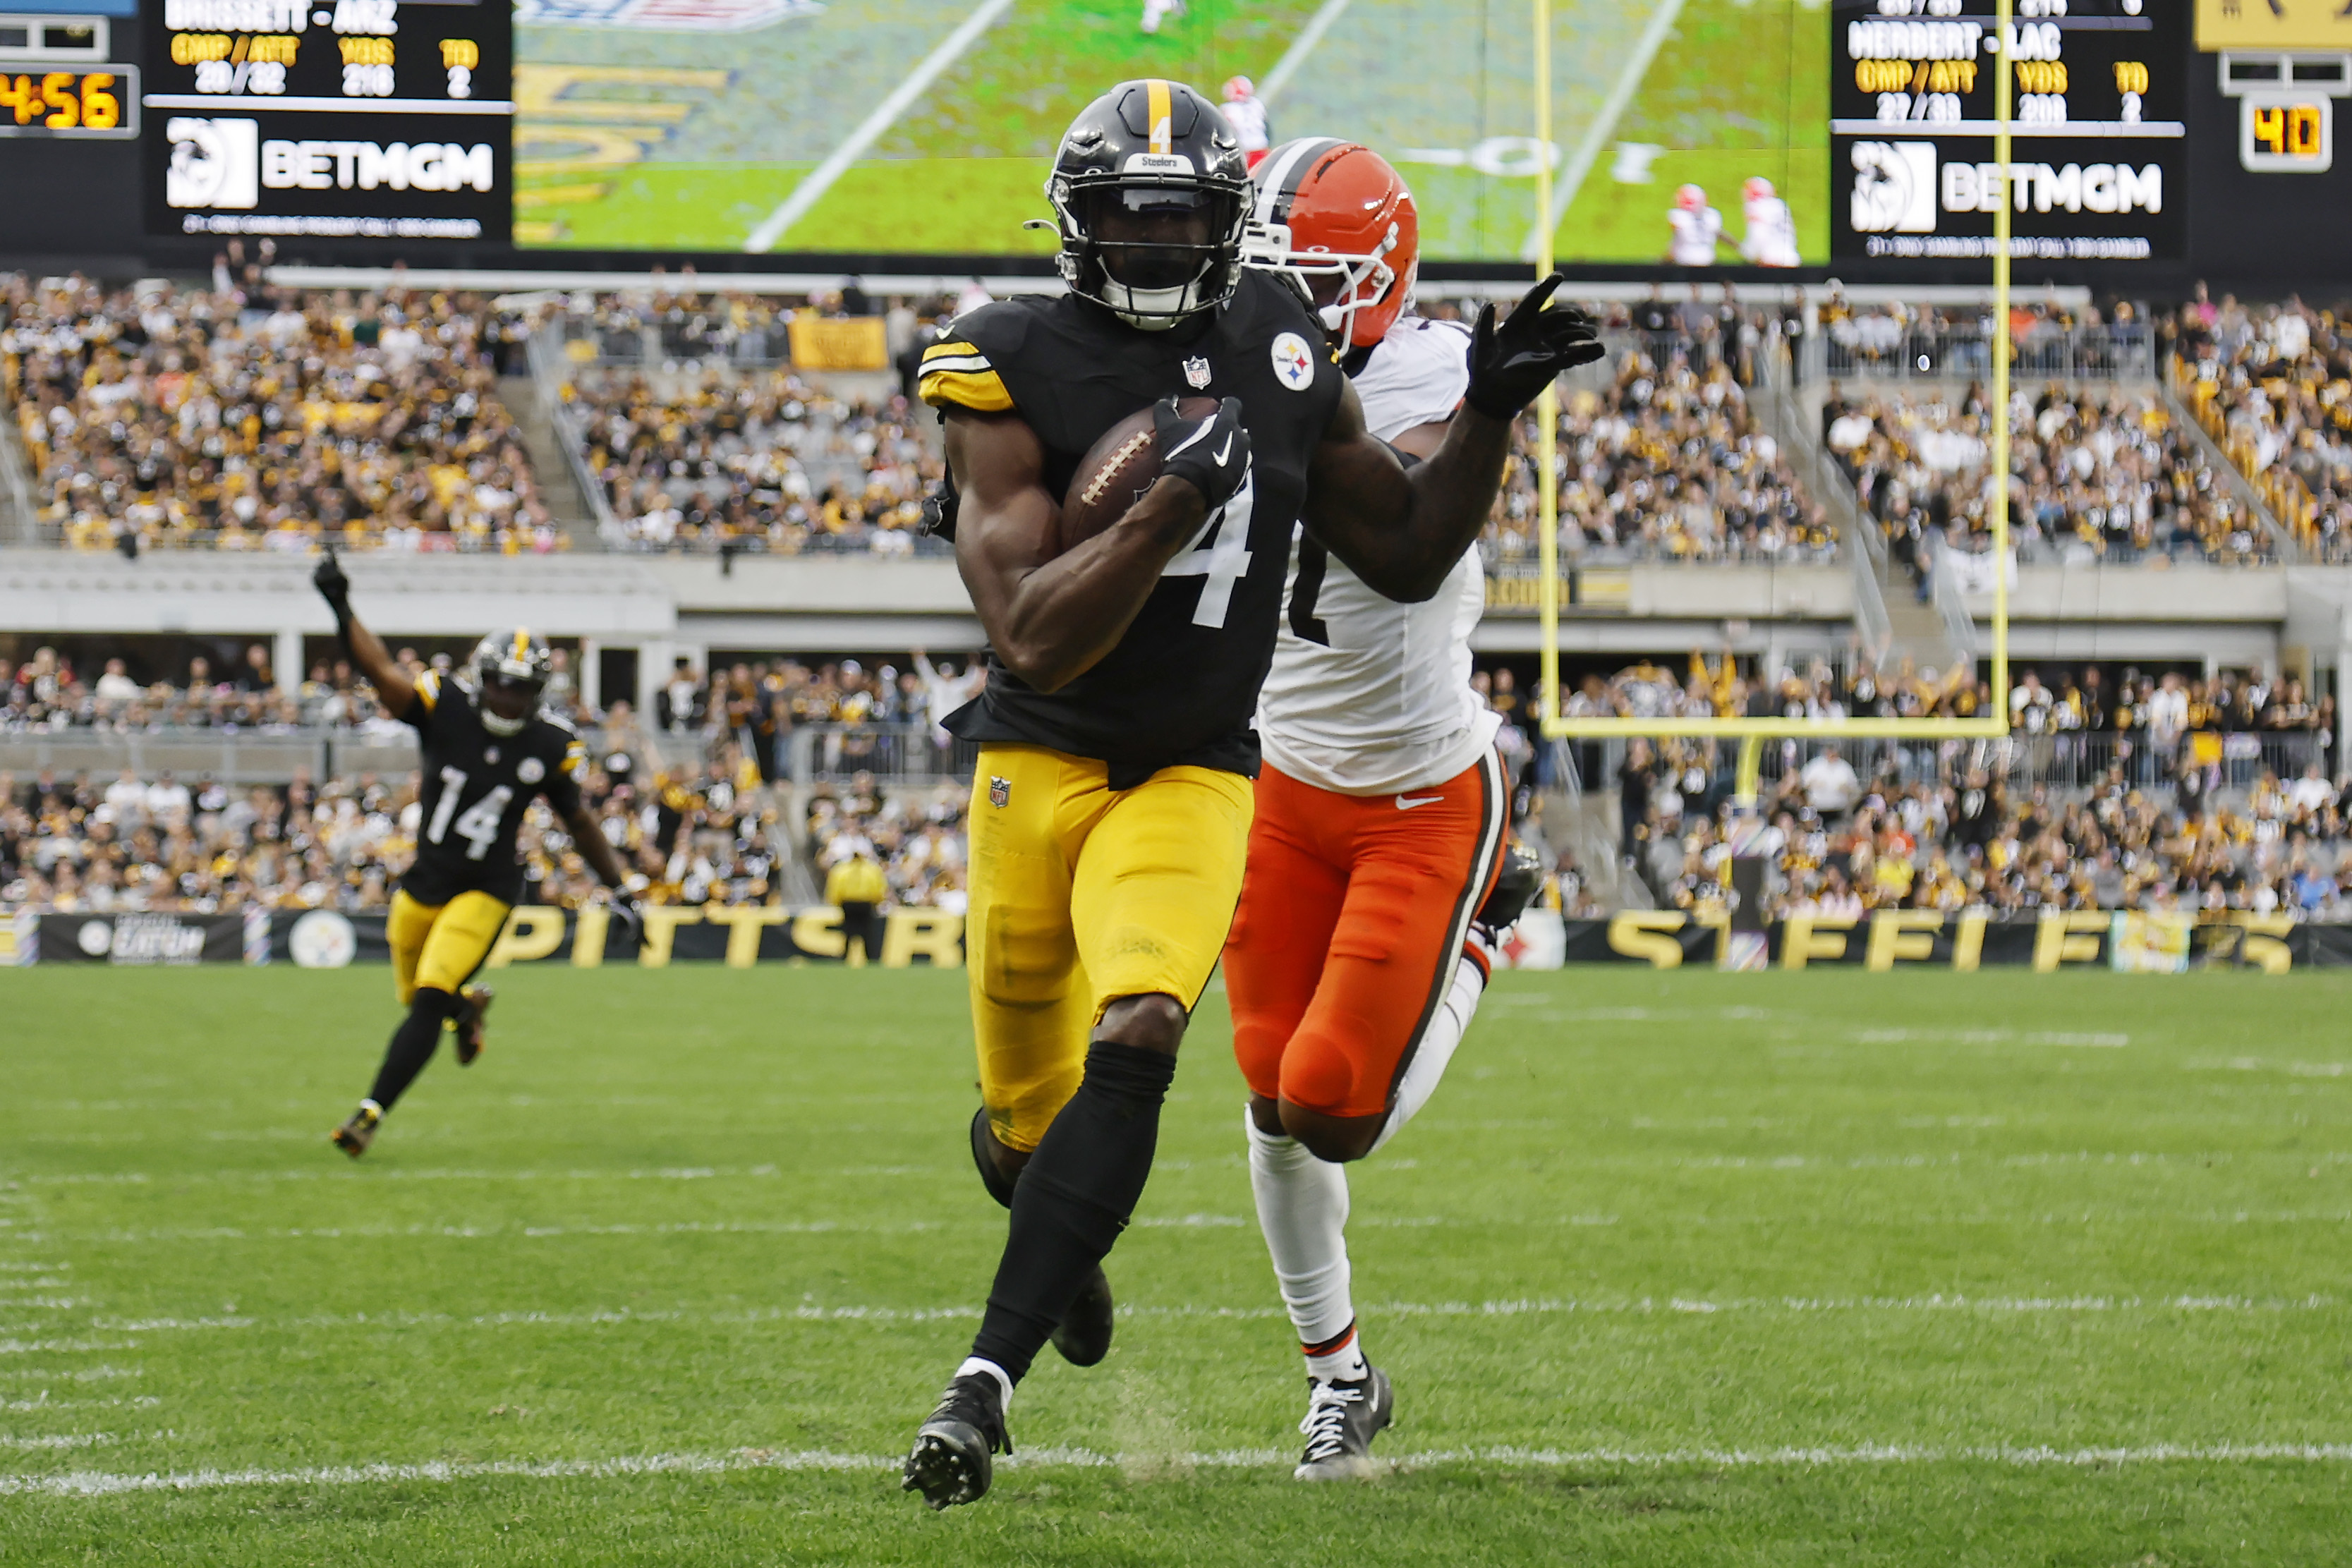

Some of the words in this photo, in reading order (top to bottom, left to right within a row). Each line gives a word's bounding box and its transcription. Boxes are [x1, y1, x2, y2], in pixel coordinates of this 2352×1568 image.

[1848, 20, 1982, 61] HERBERT
[2004, 21, 2062, 62] LAC
[447, 65, 472, 99] 2
[2016, 60, 2068, 95] YDS
[1149, 116, 1172, 154] 4
[2254, 104, 2323, 161] 40
[261, 140, 493, 193] BETMGM
[1141, 156, 1178, 167] Steelers
[1941, 162, 2163, 214] BETMGM
[1190, 370, 1208, 383] NFL
[425, 763, 515, 861] 14
